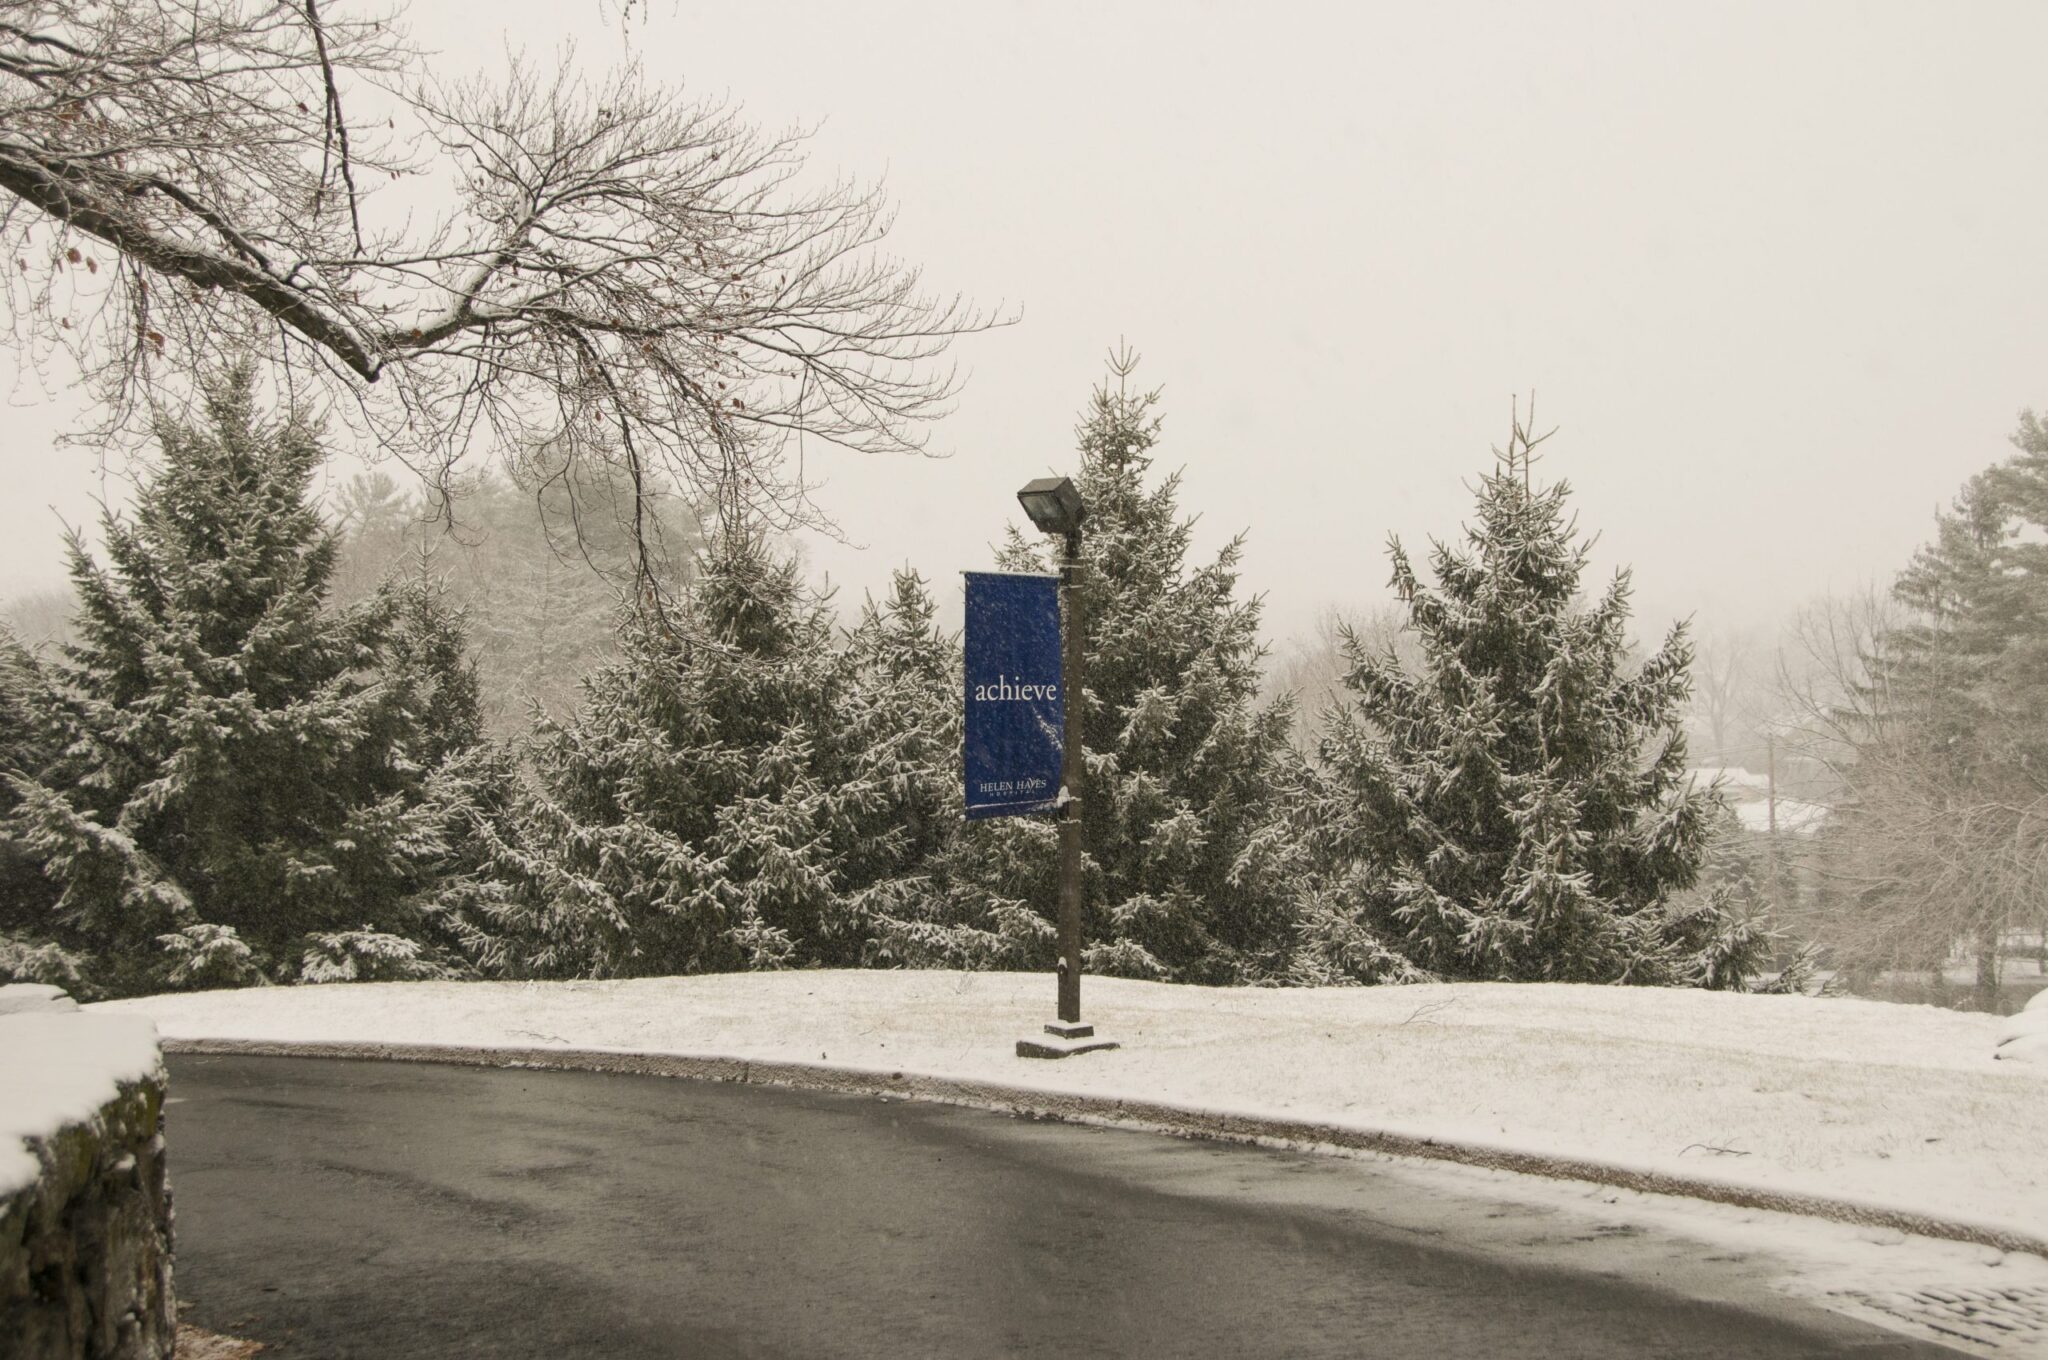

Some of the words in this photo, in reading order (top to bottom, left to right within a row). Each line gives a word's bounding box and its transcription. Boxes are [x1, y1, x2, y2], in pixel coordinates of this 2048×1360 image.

[975, 674, 1057, 701] achieve
[980, 781, 1013, 793] HELEN
[1016, 777, 1047, 791] HAYES
